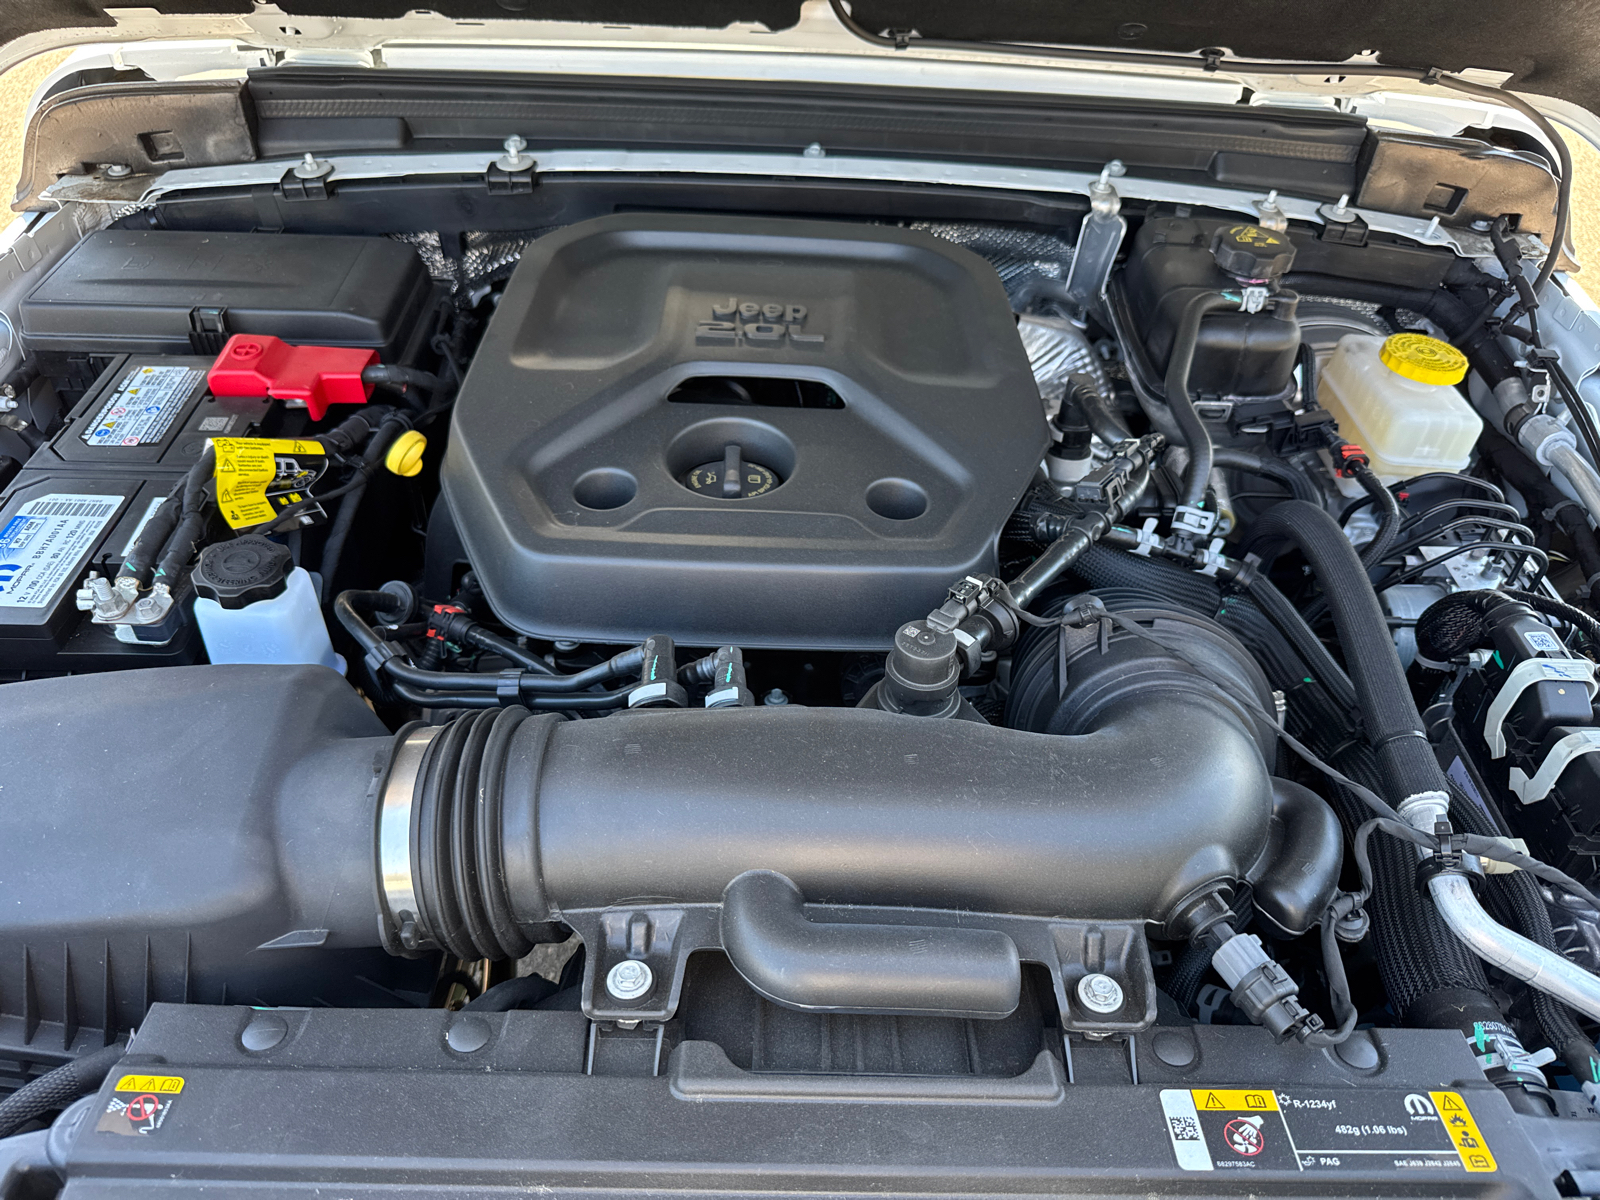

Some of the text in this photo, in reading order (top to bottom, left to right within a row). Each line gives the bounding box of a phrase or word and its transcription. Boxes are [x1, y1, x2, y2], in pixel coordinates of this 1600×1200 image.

[712, 298, 808, 322] Jeep
[6, 564, 34, 594] MOPAR
[1293, 1099, 1337, 1110] R-1234yf
[1335, 1125, 1408, 1136] 482g (1.06 lbs)
[1319, 1157, 1340, 1166] PAG
